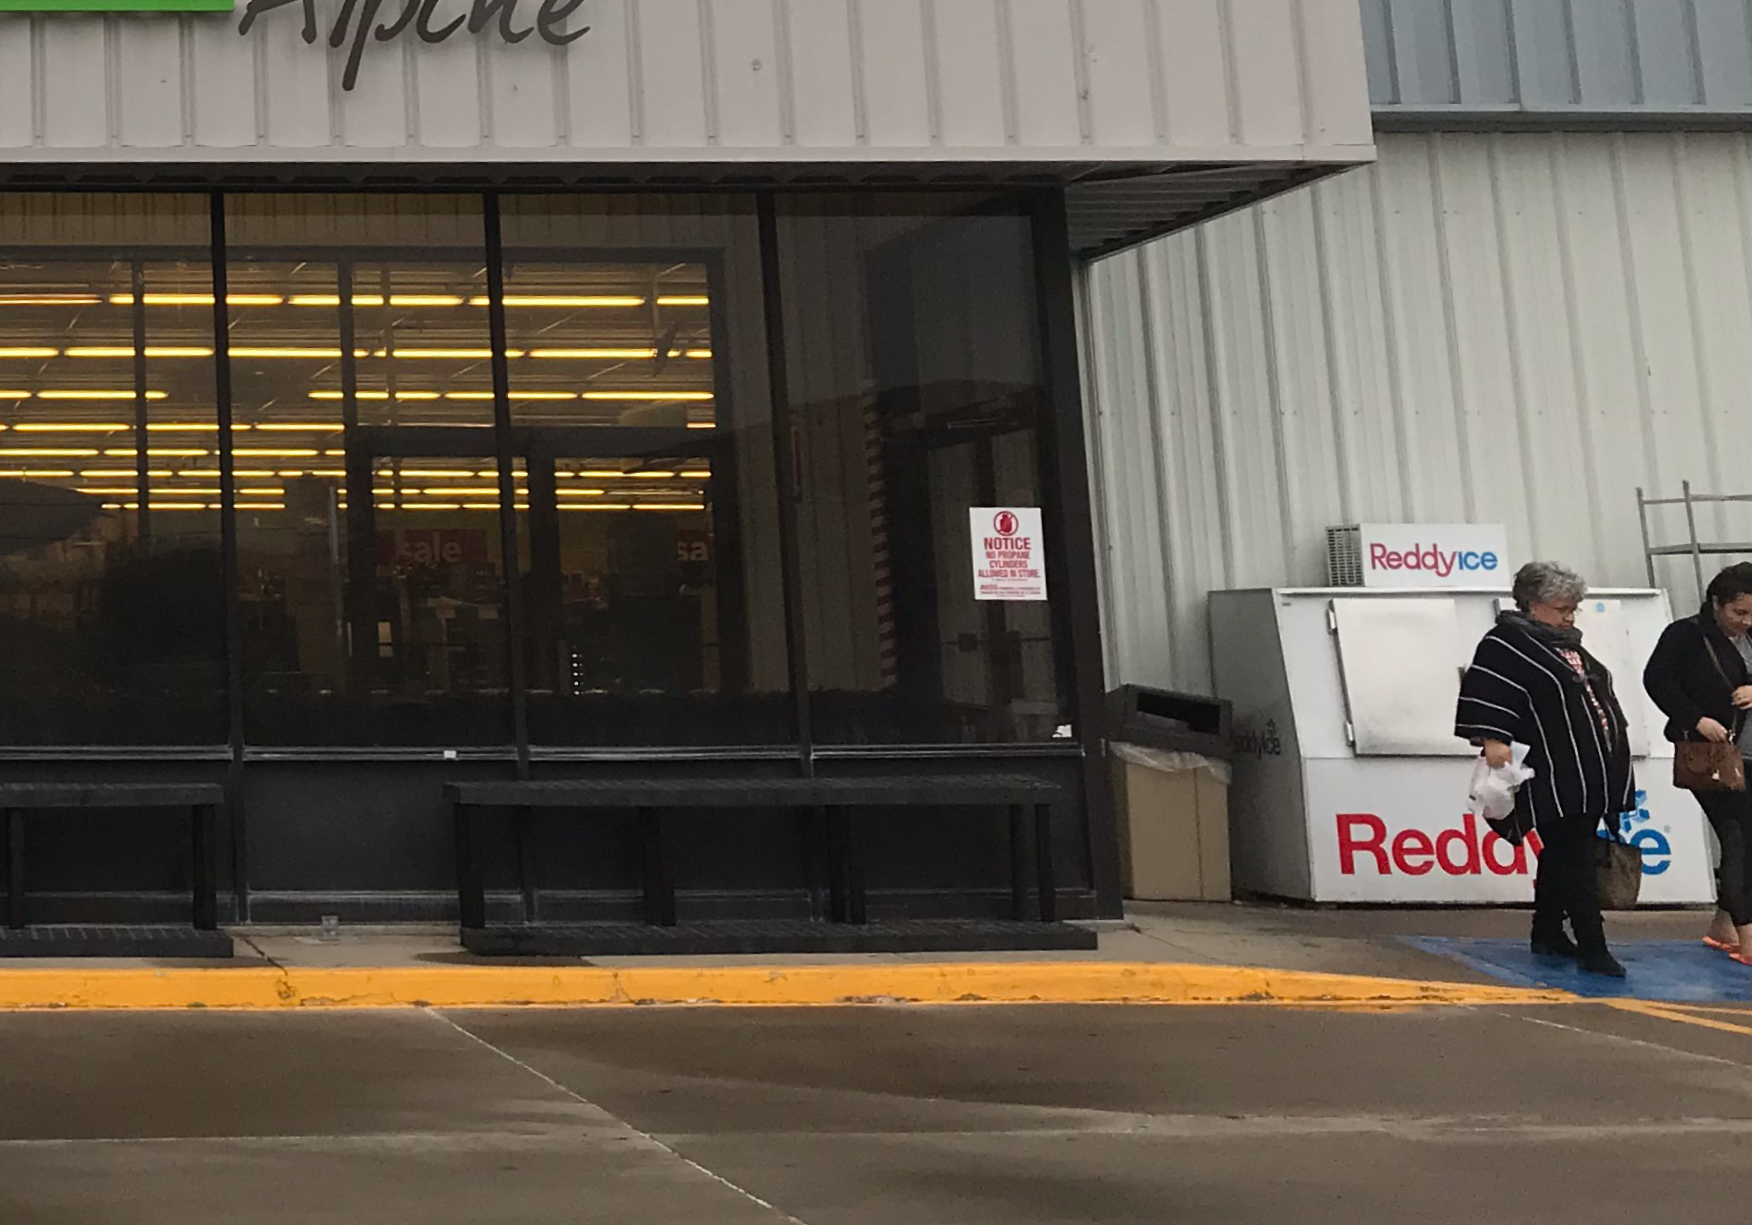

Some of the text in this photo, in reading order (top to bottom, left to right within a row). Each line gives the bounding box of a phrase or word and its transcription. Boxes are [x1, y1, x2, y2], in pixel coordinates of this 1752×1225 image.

[984, 537, 1031, 550] NOTICE
[998, 551, 1030, 559] PROPANE
[989, 560, 1028, 568] CYLINDERS
[978, 569, 1008, 577] ALLOWED
